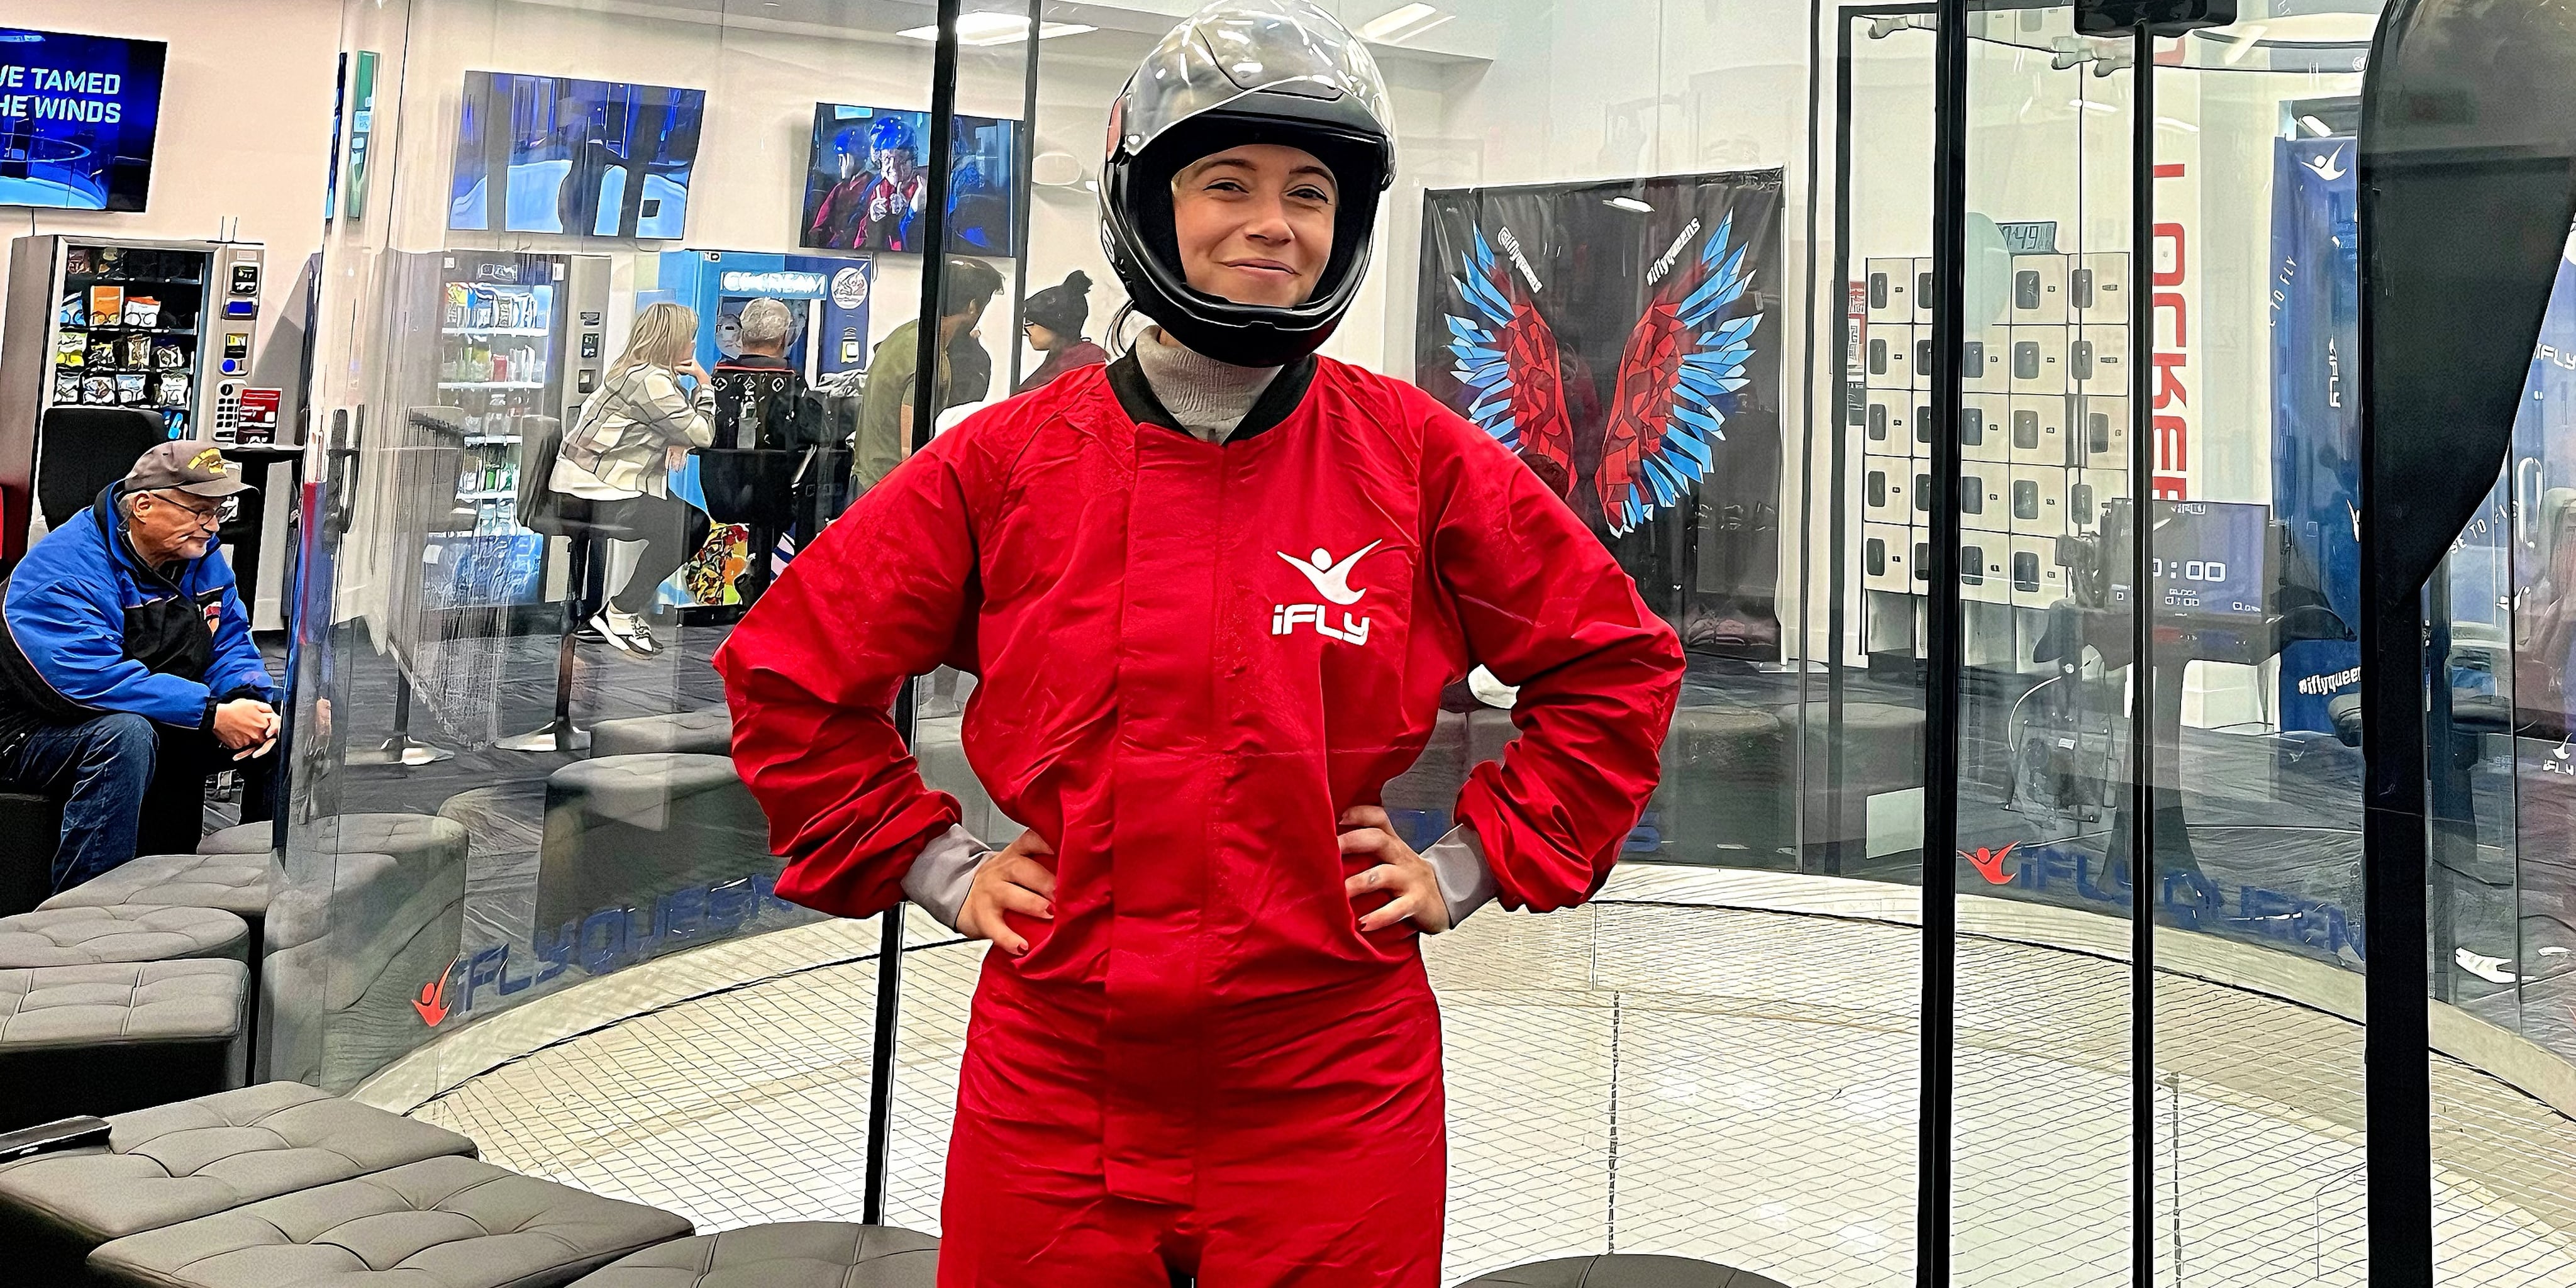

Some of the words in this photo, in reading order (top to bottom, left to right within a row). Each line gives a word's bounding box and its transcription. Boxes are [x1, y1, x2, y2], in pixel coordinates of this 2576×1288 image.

[31, 67, 121, 95] TAMED
[35, 96, 121, 123] WINDS
[2279, 255, 2297, 286] FLY
